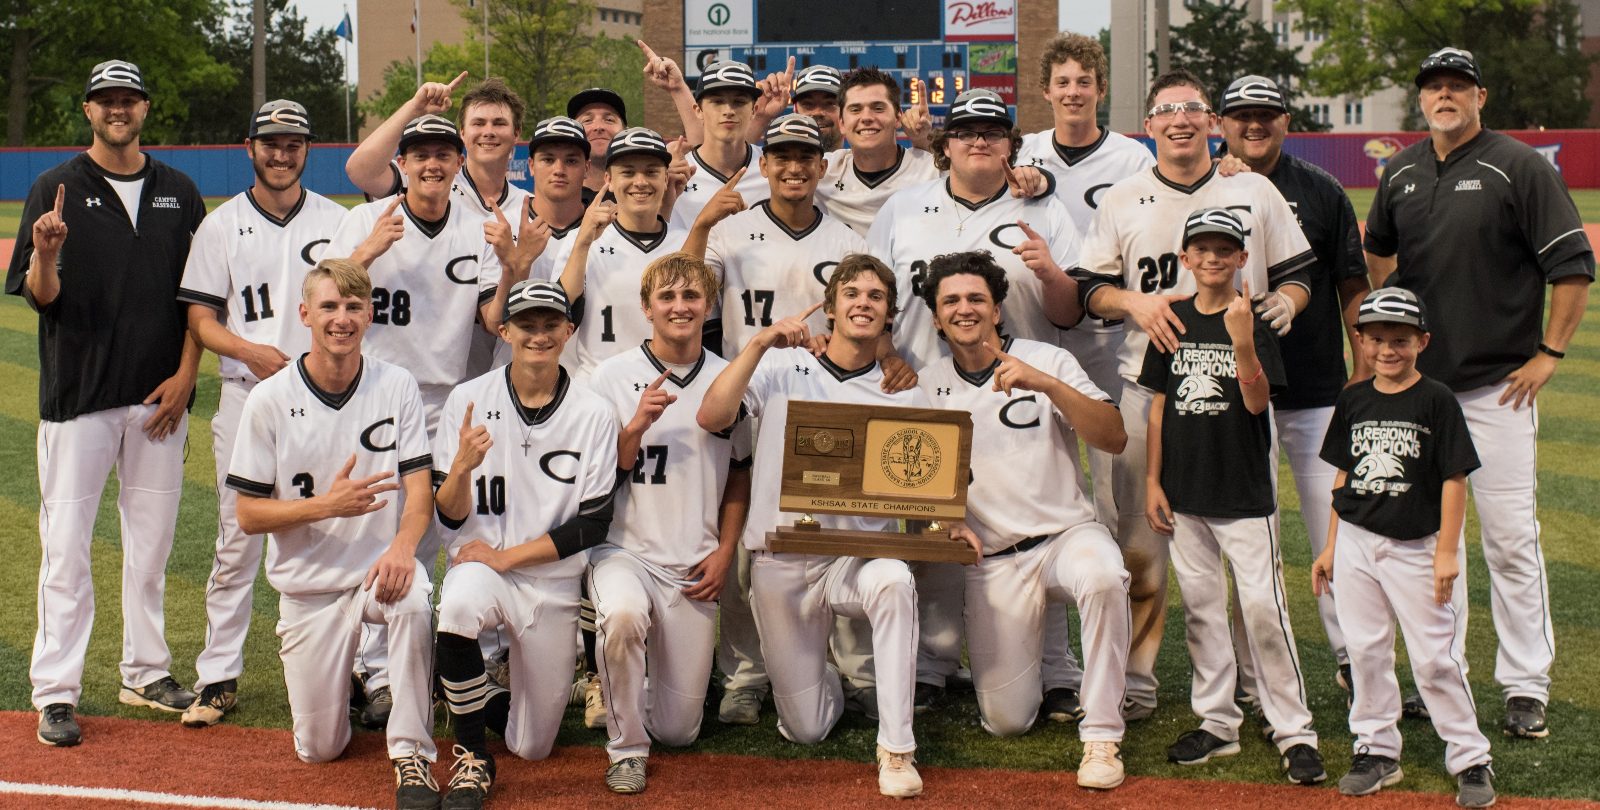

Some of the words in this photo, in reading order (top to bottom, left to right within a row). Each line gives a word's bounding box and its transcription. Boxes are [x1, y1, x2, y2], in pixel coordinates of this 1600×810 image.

[948, 2, 1013, 25] Dillons
[797, 47, 815, 55] BALL
[840, 46, 866, 54] STRIKE
[910, 77, 918, 90] 2
[935, 77, 944, 90] 9
[955, 77, 963, 90] 3
[911, 91, 919, 103] 3
[932, 91, 944, 103] 12
[445, 254, 479, 285] C
[1138, 252, 1178, 293] 20
[241, 283, 274, 322] 11
[372, 287, 411, 326] 28
[741, 290, 775, 326] 17
[601, 305, 615, 342] 1
[1183, 349, 1236, 364] REGIONAL
[999, 394, 1041, 430] C
[1194, 401, 1203, 411] 2
[1205, 402, 1227, 411] BACK
[360, 417, 397, 452] C
[1352, 429, 1363, 443] 6A
[1363, 426, 1420, 444] REGIONAL
[539, 449, 581, 484] C
[1374, 481, 1381, 491] 2
[476, 475, 505, 516] 10
[811, 499, 846, 508] KSHSAA
[883, 503, 936, 513] CHAMPIONS
